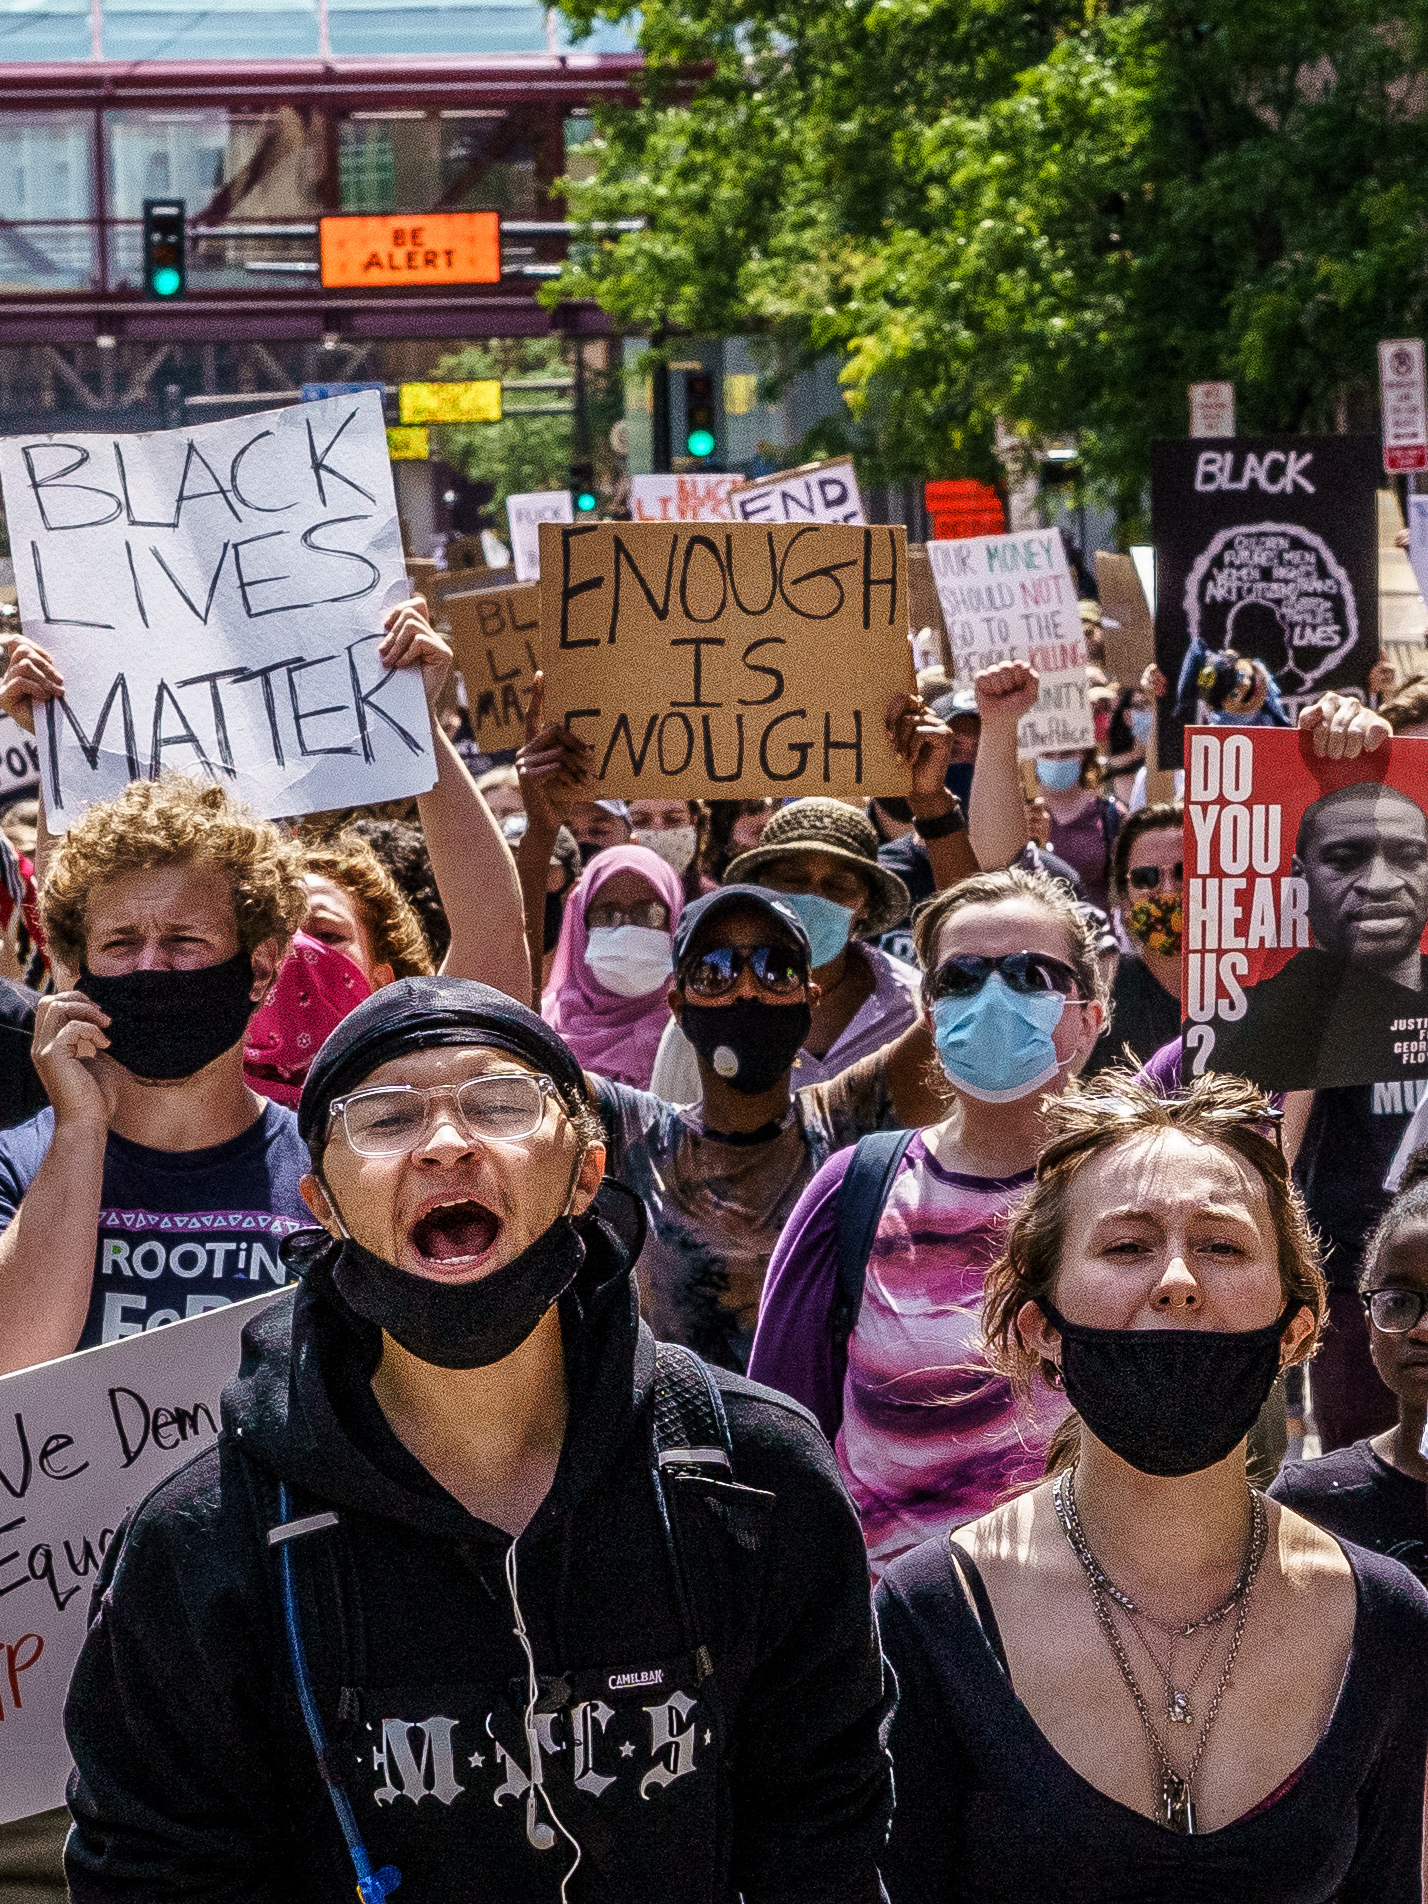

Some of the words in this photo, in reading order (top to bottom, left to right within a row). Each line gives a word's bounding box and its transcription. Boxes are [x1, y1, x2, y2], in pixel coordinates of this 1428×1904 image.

[363, 250, 455, 272] ALERT
[392, 227, 425, 248] BE
[21, 406, 378, 531] BLACK
[739, 476, 851, 521] END
[1194, 450, 1316, 493] BLACK
[30, 514, 381, 629] LIVES
[985, 537, 1055, 573] MONEY
[558, 526, 898, 650] ENOUGH
[1019, 574, 1066, 609] NOT
[1021, 610, 1065, 642] THE
[671, 636, 786, 708] IS
[44, 632, 426, 810] MATTER
[1189, 734, 1254, 803] DO
[1188, 803, 1282, 876] YOU
[1187, 876, 1310, 950] HEAR
[1187, 951, 1249, 1022] US
[1186, 1024, 1216, 1076] ?
[1402, 1053, 1428, 1065] FLO
